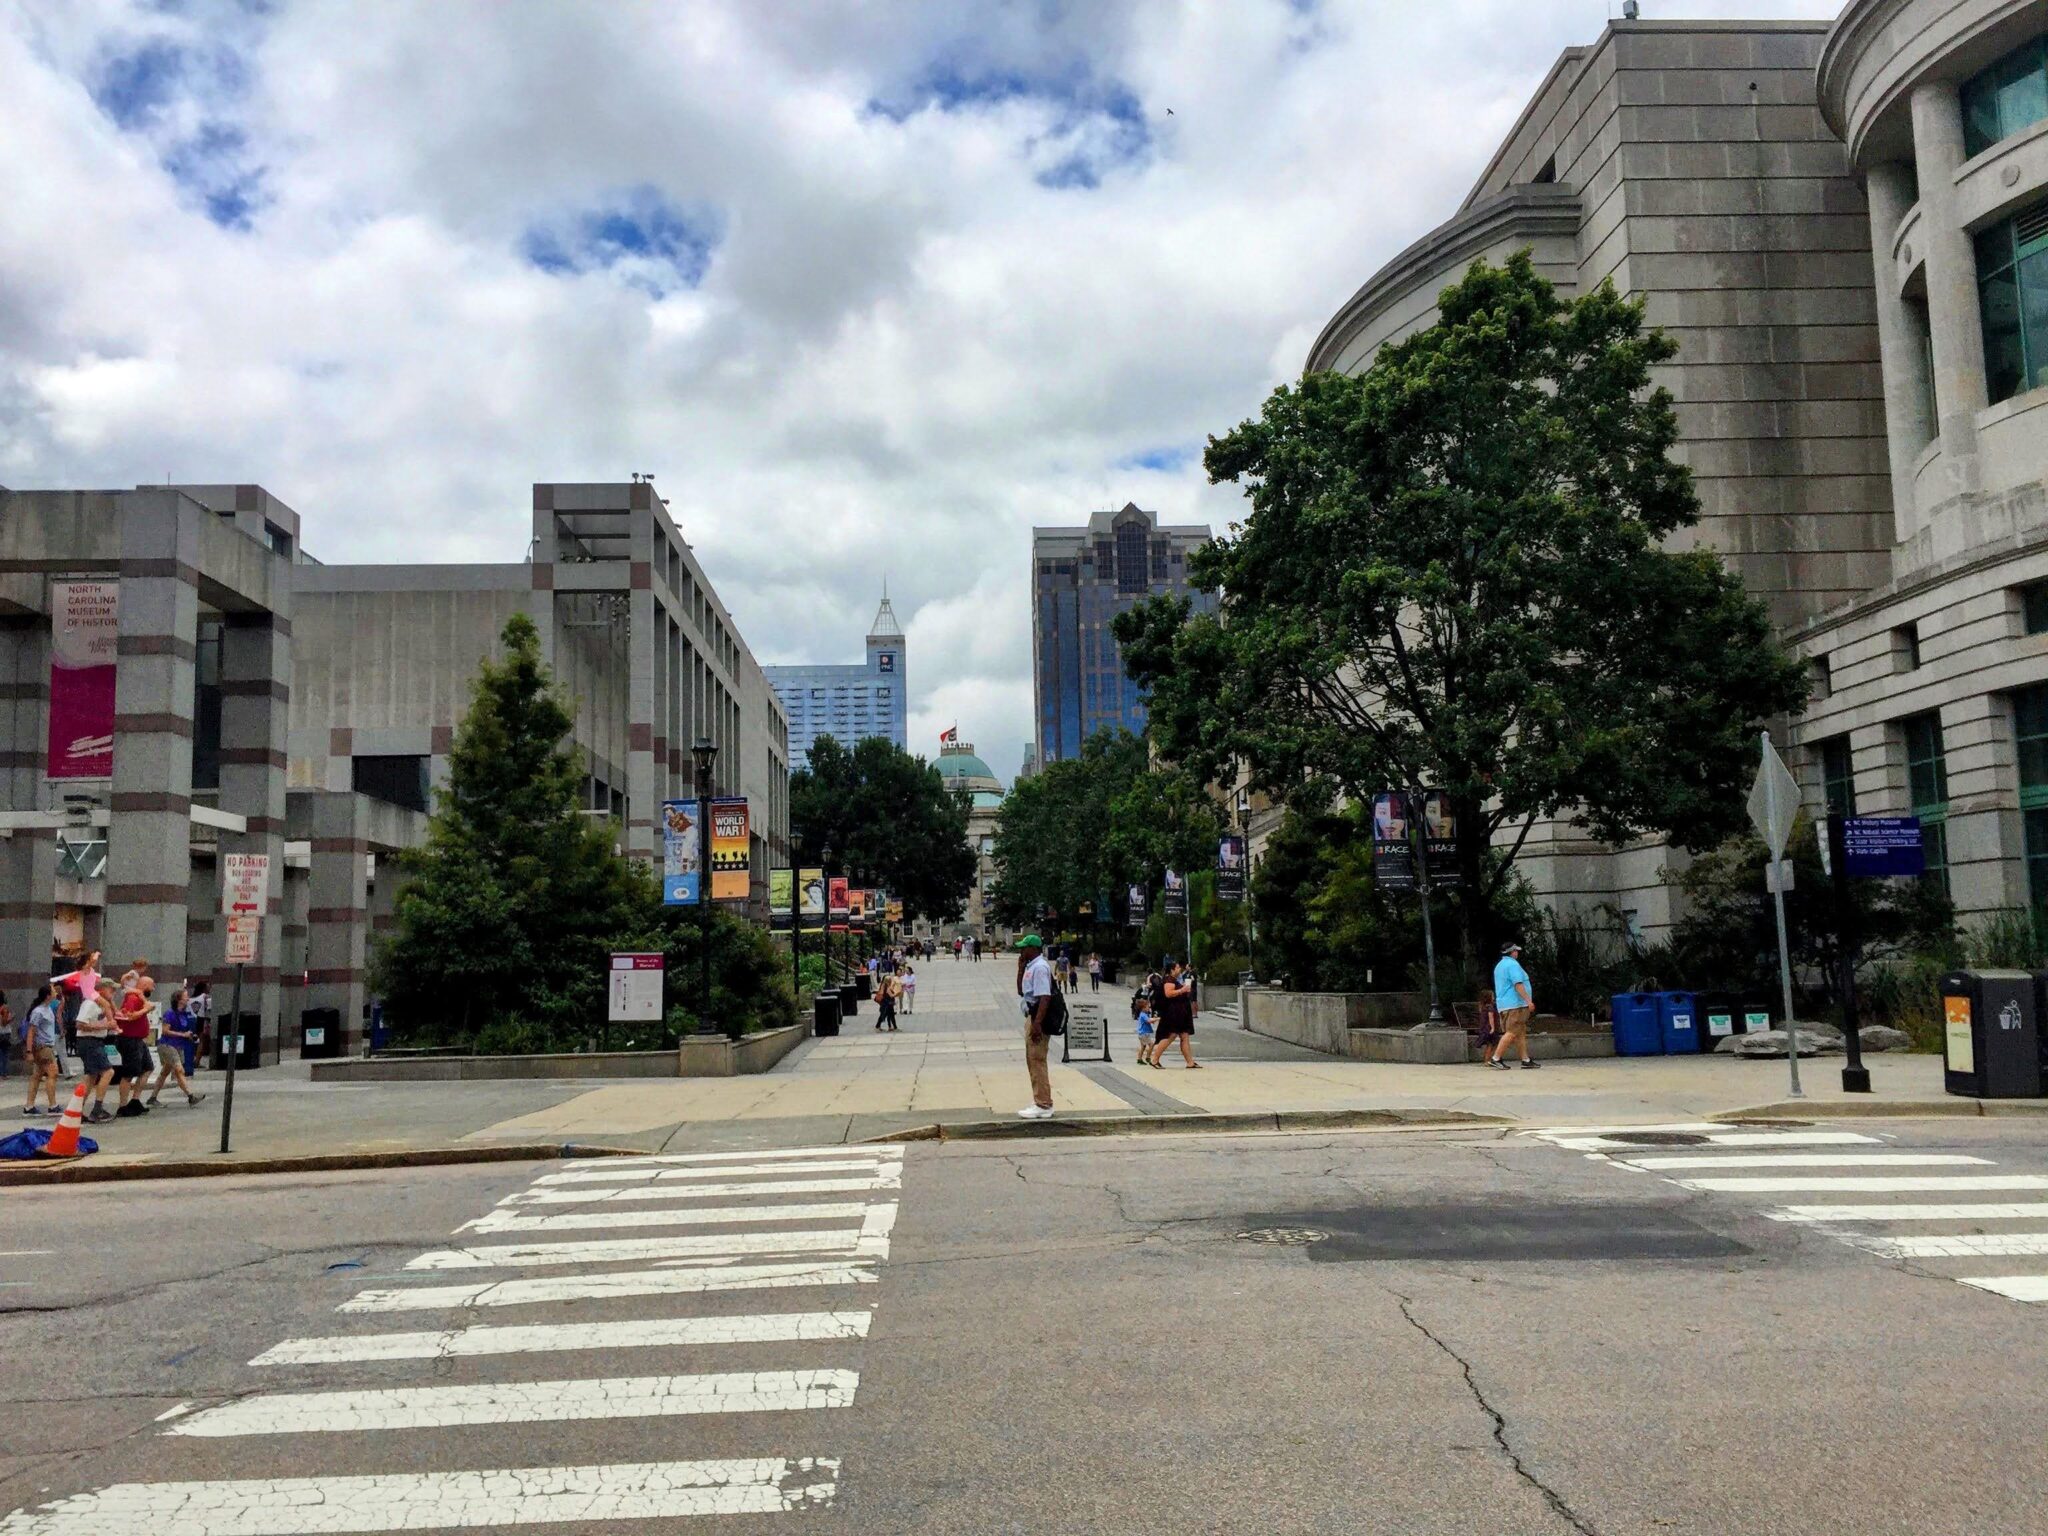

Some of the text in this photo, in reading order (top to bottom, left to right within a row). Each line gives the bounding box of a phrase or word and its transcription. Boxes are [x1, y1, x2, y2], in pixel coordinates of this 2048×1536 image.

[68, 585, 102, 594] NORTH
[68, 596, 116, 605] CAROLINA
[67, 607, 111, 616] MUSEUM
[67, 617, 118, 627] OF HISTOR
[715, 816, 744, 825] WORLD
[715, 825, 745, 837] WAR I
[1384, 845, 1410, 854] RACE
[1434, 844, 1457, 852] RACE
[227, 857, 268, 867] NO PARKING
[232, 944, 250, 953] TIME
